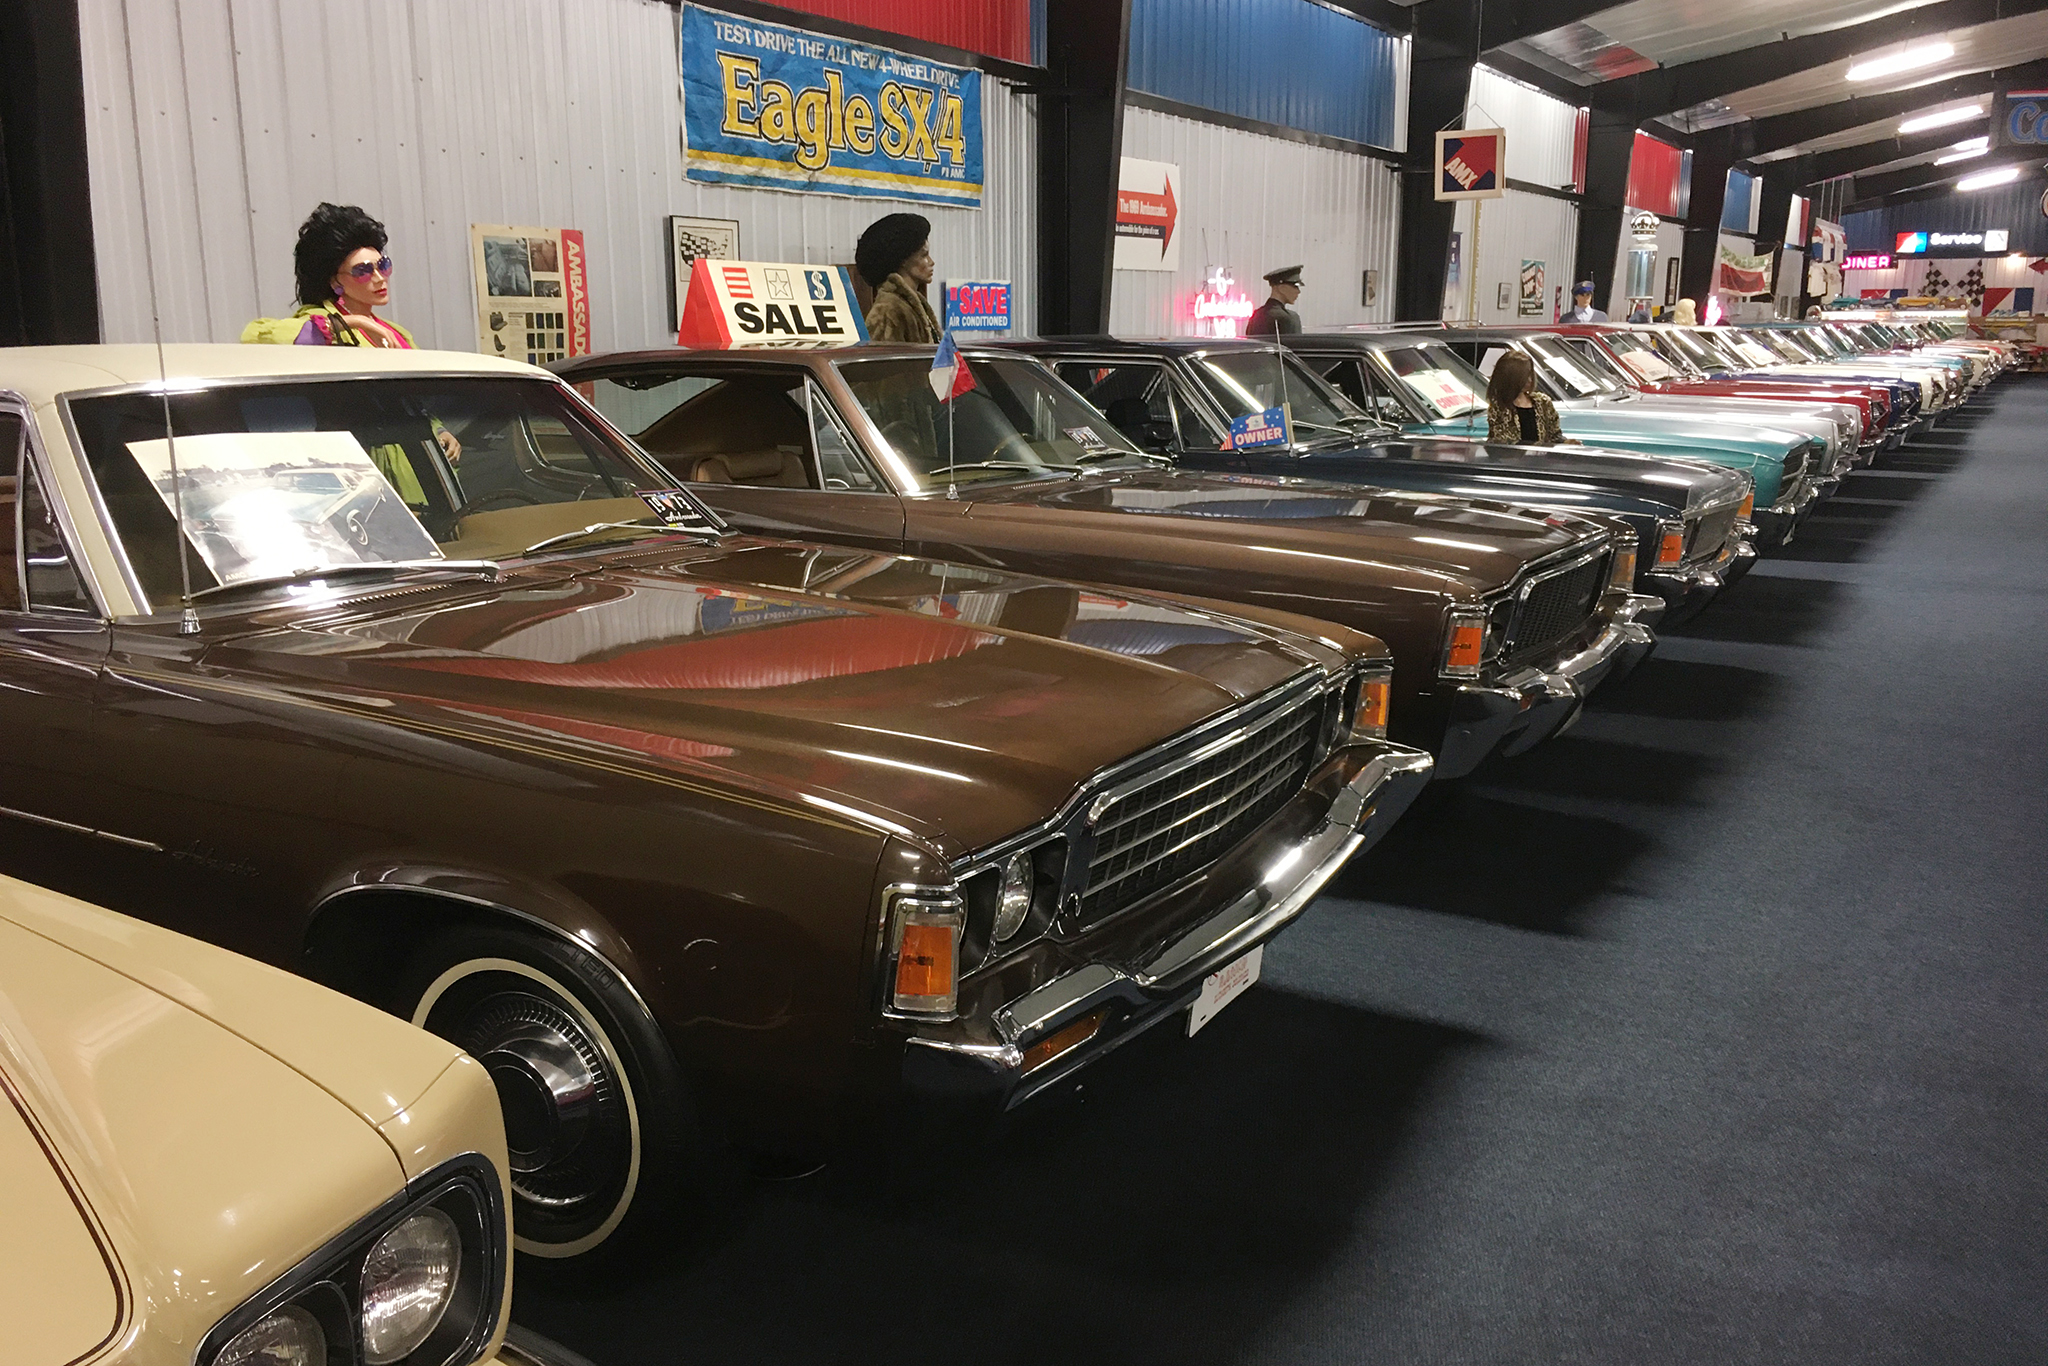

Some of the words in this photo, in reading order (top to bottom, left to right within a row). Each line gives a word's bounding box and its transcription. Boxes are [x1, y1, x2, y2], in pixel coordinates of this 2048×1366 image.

[713, 20, 751, 45] TEST
[754, 29, 796, 56] DRIVE
[797, 38, 825, 60] THE
[825, 45, 850, 66] ALL
[851, 49, 880, 71] NEW
[930, 67, 961, 89] DRIVE
[716, 50, 876, 172] Eagle
[1444, 156, 1478, 191] AMX
[1930, 232, 1983, 246] Service
[734, 301, 845, 335] SALE
[949, 315, 960, 327] AIR
[961, 315, 1008, 327] CONDITIONED
[1234, 427, 1283, 446] OWNER
